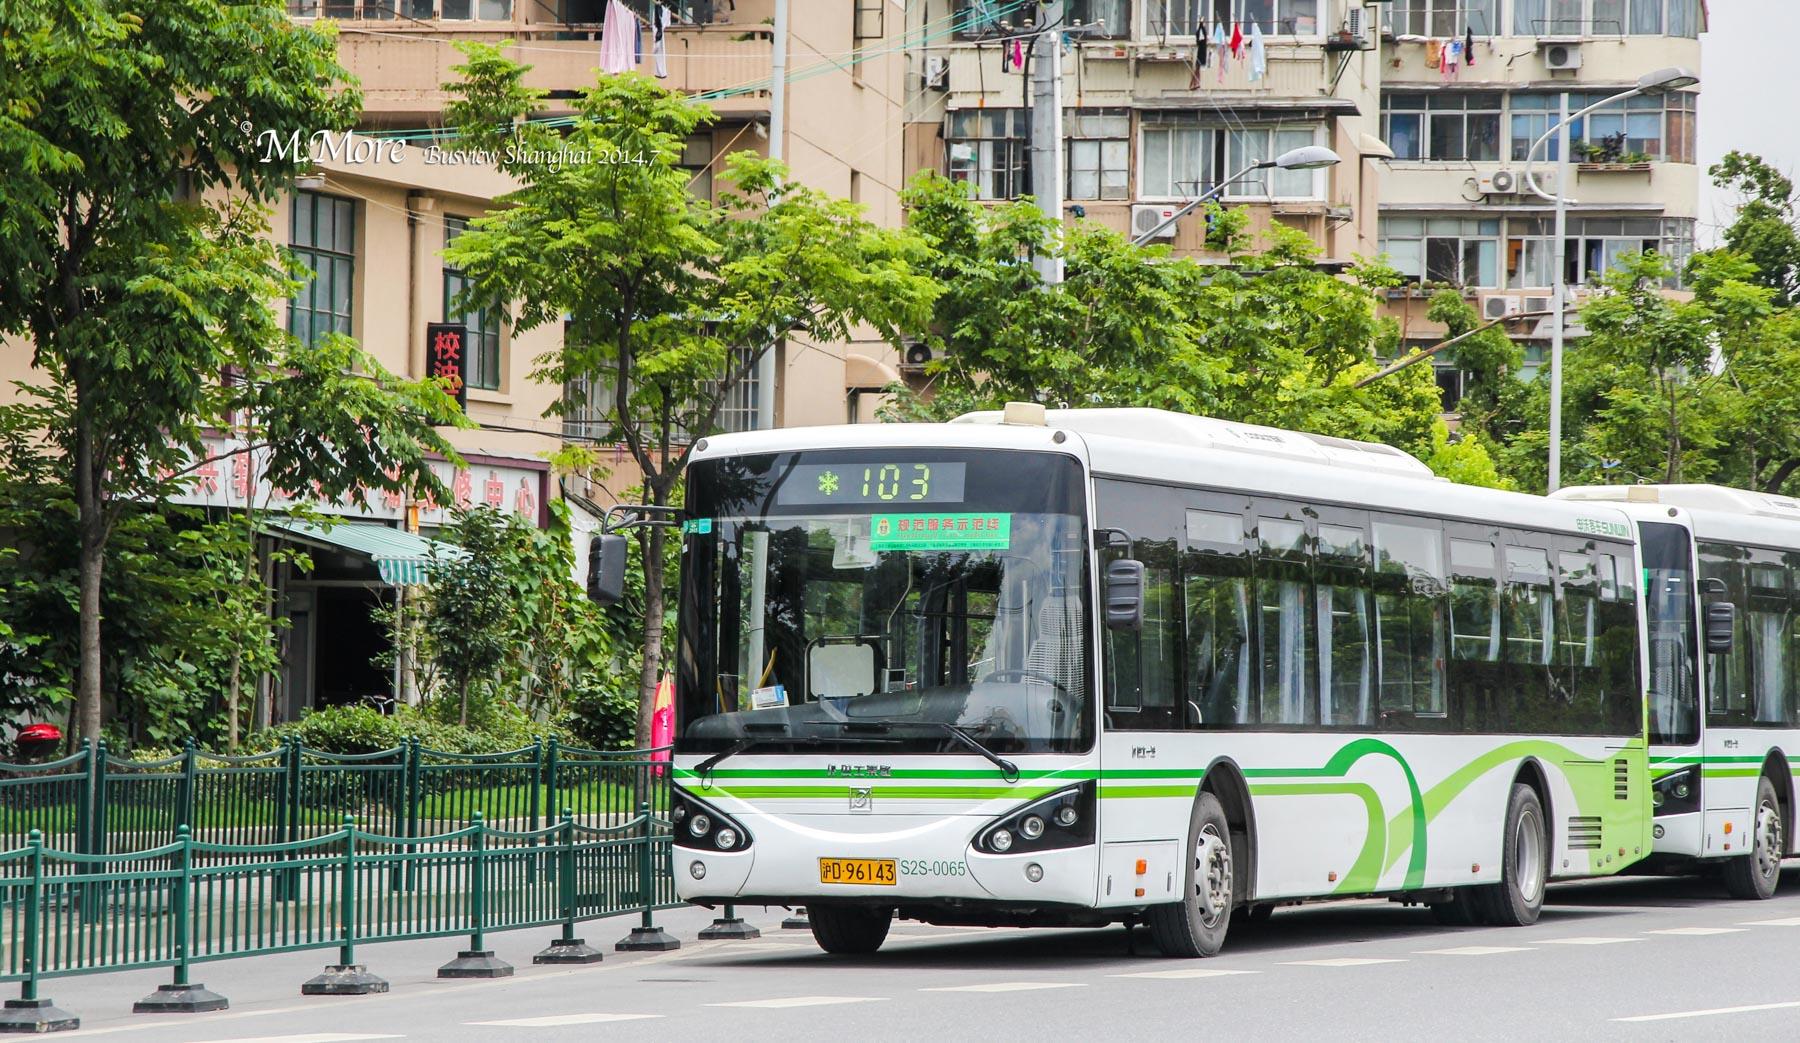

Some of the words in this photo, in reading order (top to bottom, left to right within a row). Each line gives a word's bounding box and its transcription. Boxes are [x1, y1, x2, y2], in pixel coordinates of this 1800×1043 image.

[434, 331, 461, 395] 校油
[862, 464, 930, 500] 103
[900, 859, 966, 877] S2S-0065
